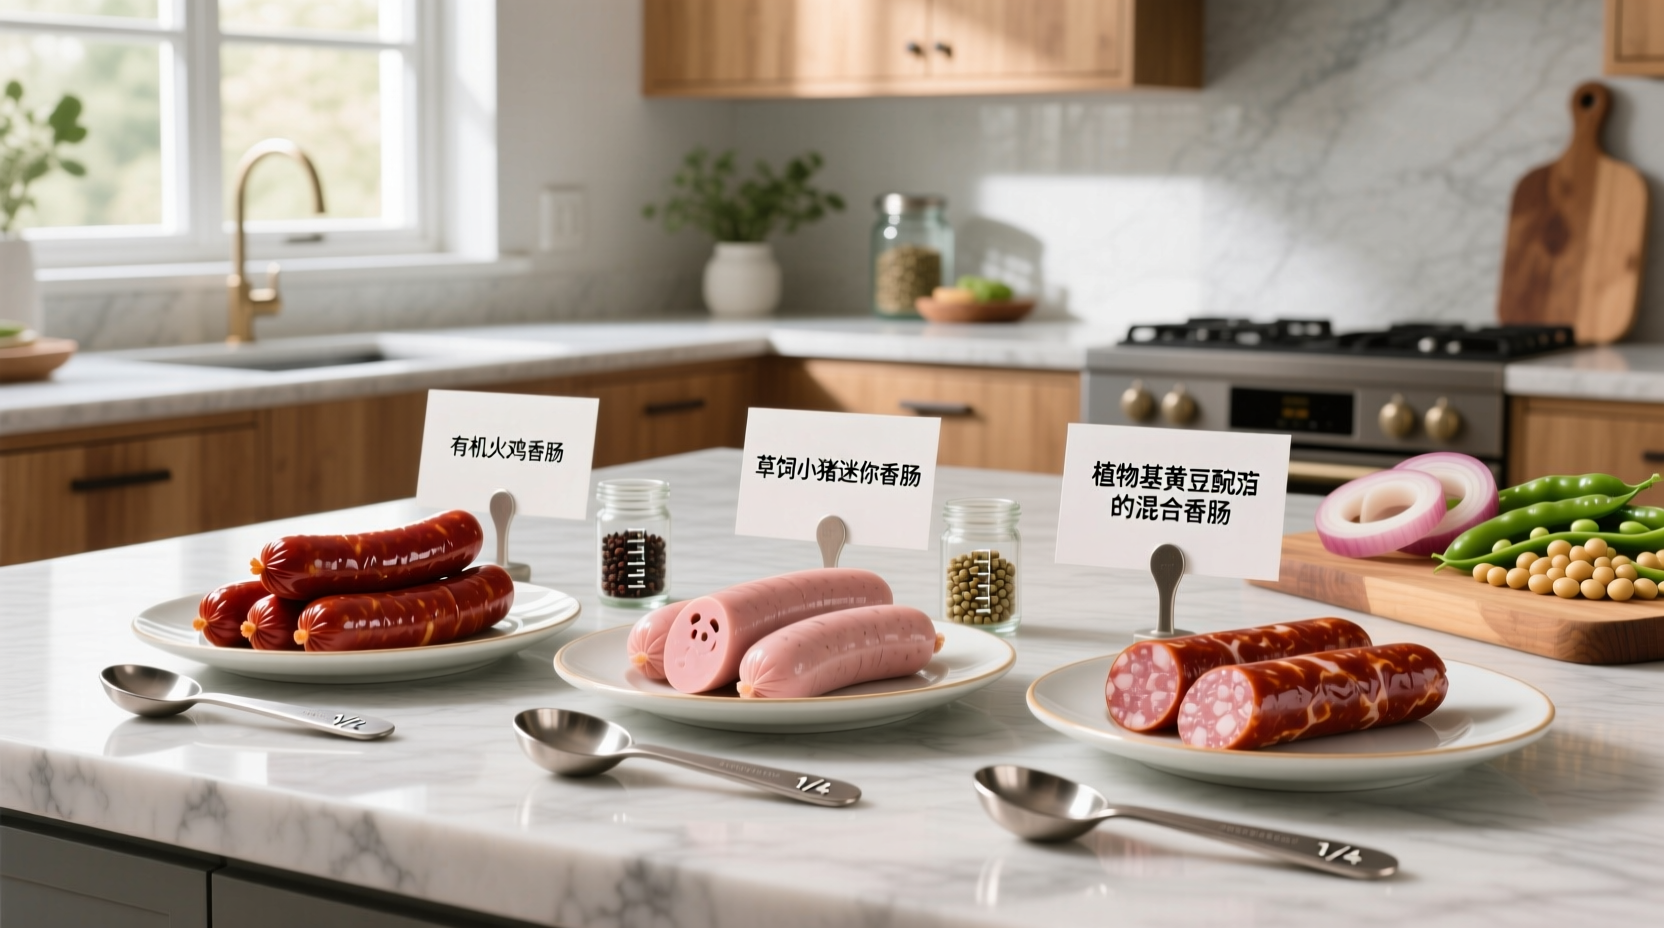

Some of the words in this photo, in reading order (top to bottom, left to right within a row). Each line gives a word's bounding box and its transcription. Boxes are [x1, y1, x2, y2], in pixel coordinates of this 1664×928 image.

[450, 434, 564, 464] 有机火鸡香肠
[755, 454, 922, 488] 草饲小猪迷你香肠
[1110, 493, 1231, 526] 的混合香肠
[796, 776, 831, 796] 1/4
[1317, 841, 1362, 866] 1/4
